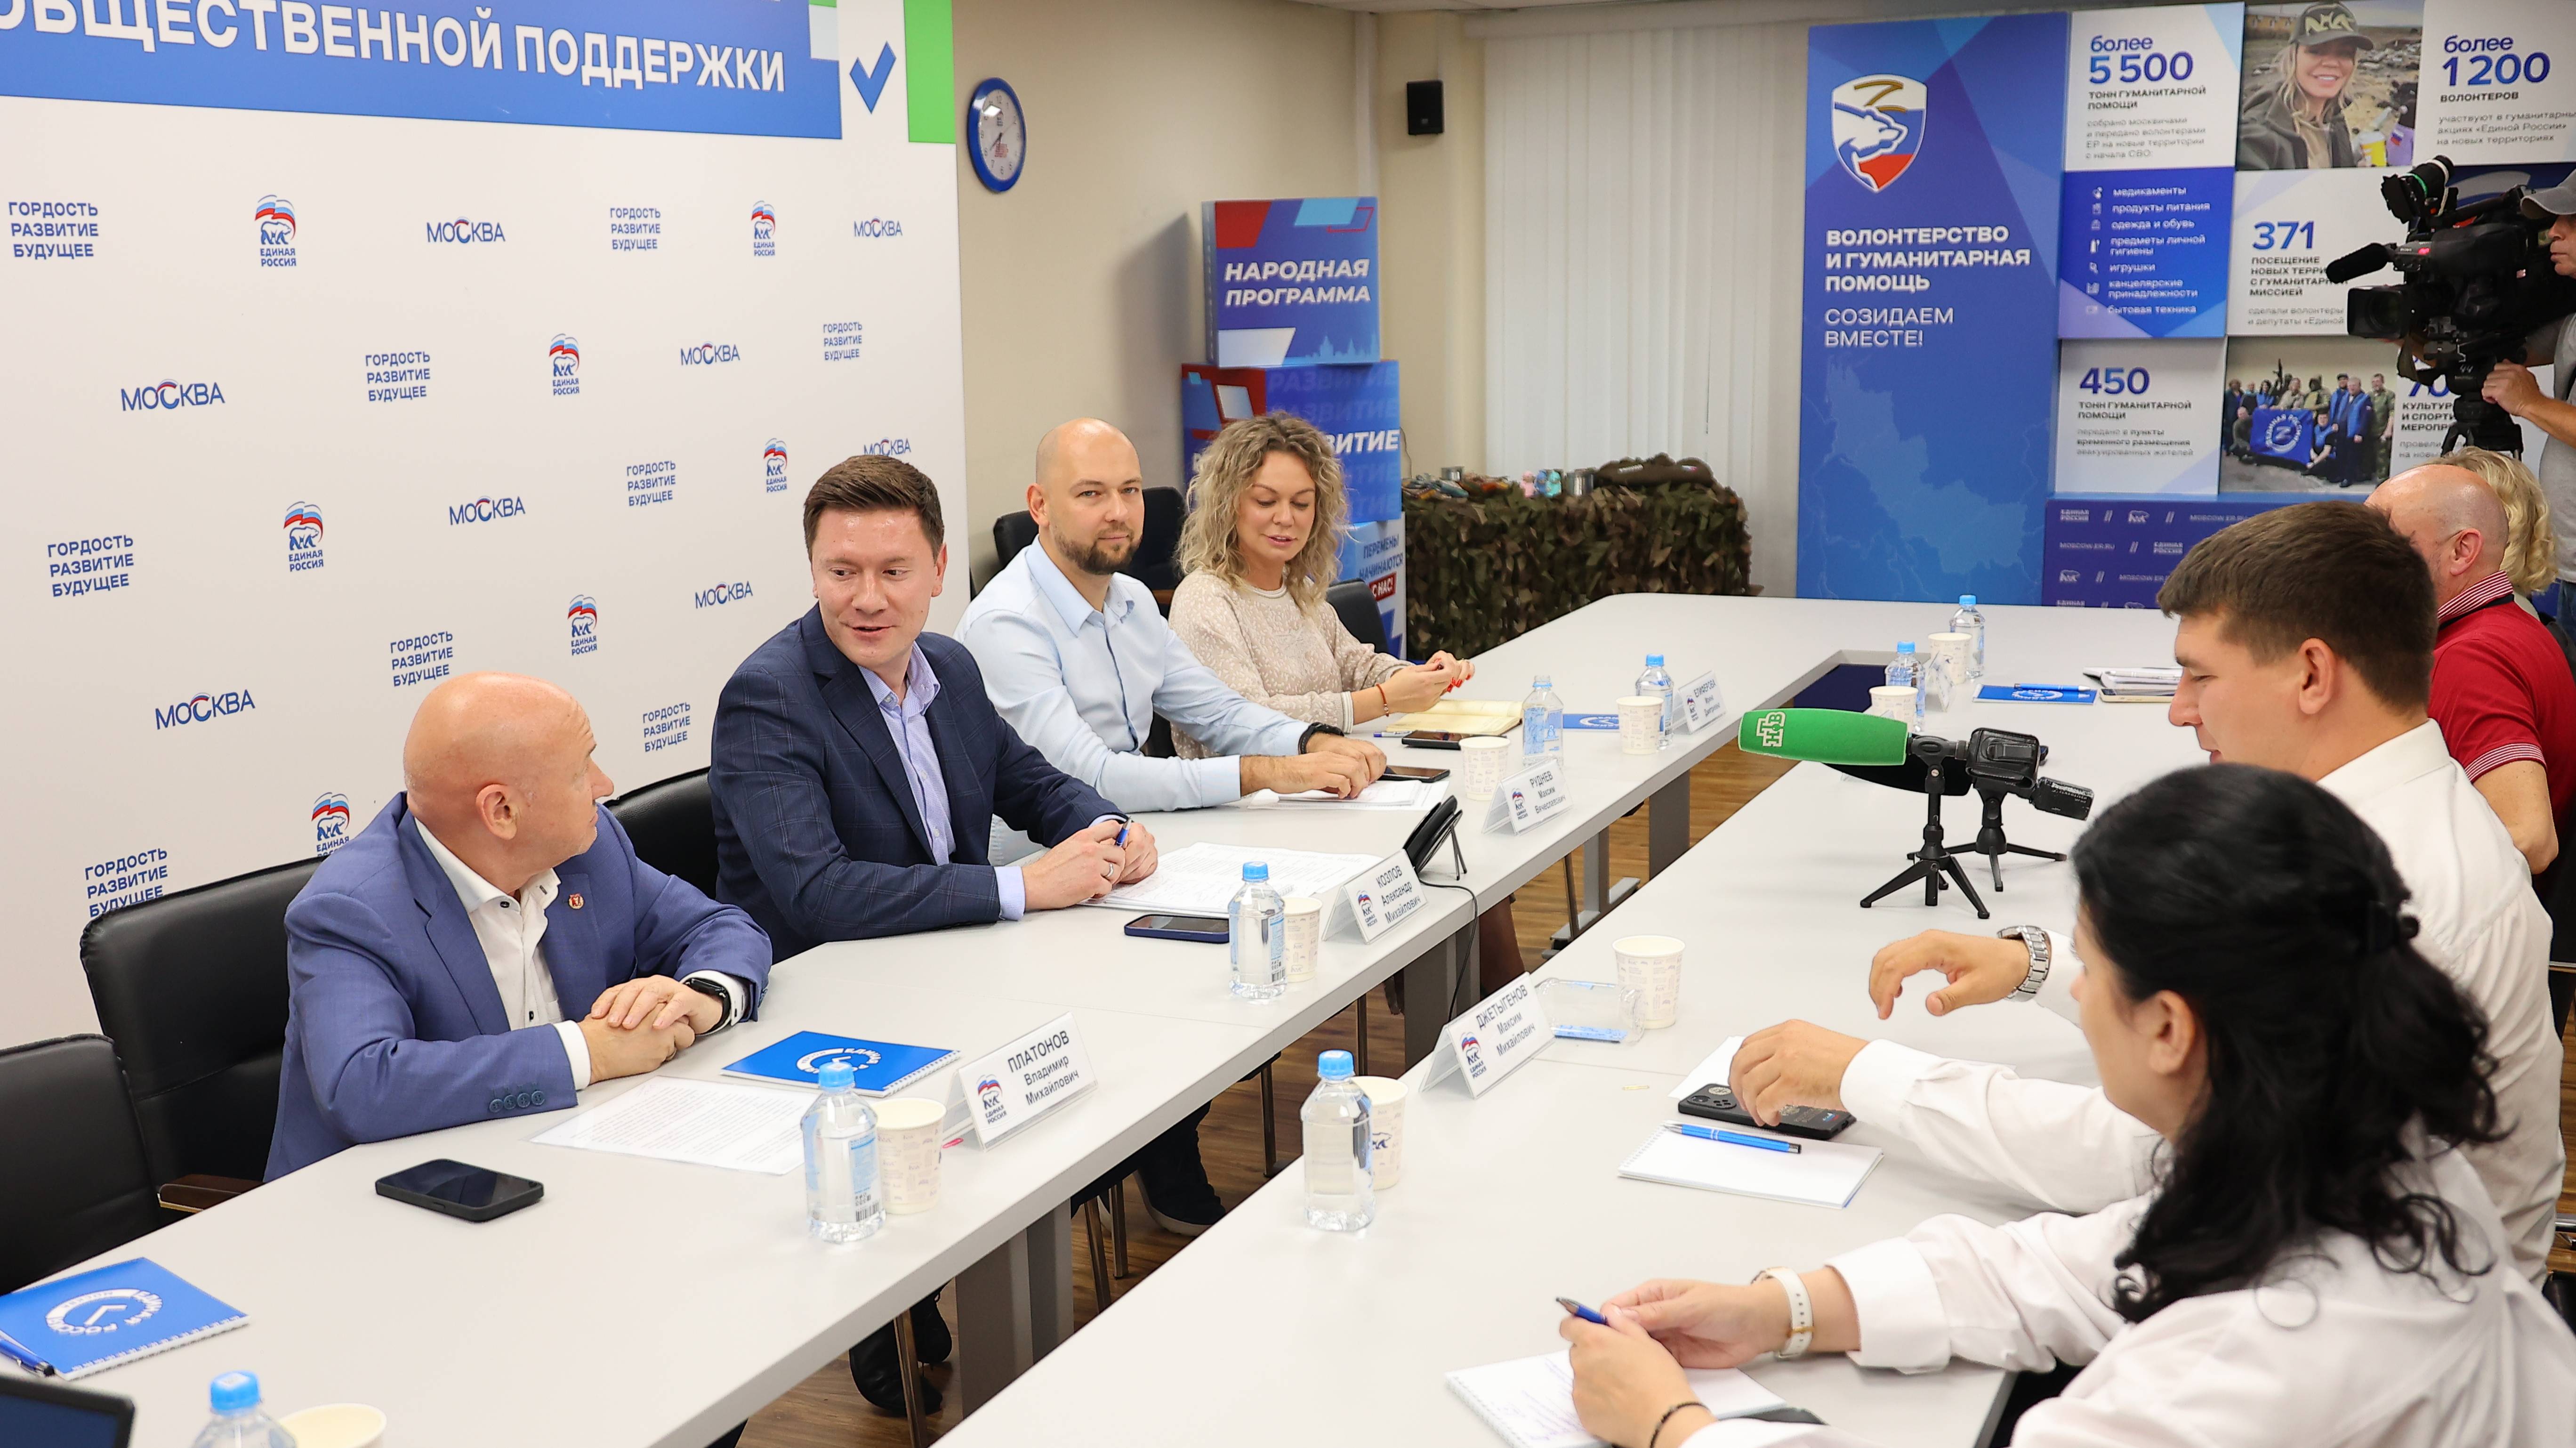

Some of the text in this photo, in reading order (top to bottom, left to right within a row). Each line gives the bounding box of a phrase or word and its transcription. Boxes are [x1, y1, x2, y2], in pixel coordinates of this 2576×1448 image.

[2091, 35, 2153, 52] более
[2444, 34, 2514, 53] более
[515, 24, 785, 92] ПОДДЕРЖКИ
[2089, 85, 2206, 99] ТОНН ГУМАНИТАРНОЙ
[2440, 91, 2519, 103] ВОЛОНТЕРОВ
[2088, 101, 2138, 110] ПОМОЩИ
[2506, 111, 2576, 121] гуманитарны
[2113, 187, 2187, 197] медикаменты
[8, 202, 98, 218] ГОРДОСТЬ
[610, 207, 660, 219] ГОРДОСТЬ
[2112, 202, 2210, 214] продукты питания
[11, 222, 98, 237] РАЗВИТИЕ
[427, 218, 505, 244] МОСКВА
[611, 222, 660, 235] РАЗВИТИЕ
[853, 218, 902, 238] МОСКВА
[2111, 220, 2151, 230] одежда
[2163, 218, 2195, 230] обувь
[1826, 226, 2009, 246] ВОЛОНТЕРСТВО
[2110, 234, 2206, 247] предметы личной
[2252, 220, 2314, 250] 371
[13, 243, 94, 259] БУДУЩЕЕ
[260, 247, 296, 258] ЕДИНАЯ
[612, 238, 658, 251] БУДУЩЕЕ
[261, 257, 297, 267] РОССИЯ
[1826, 249, 2031, 269] И ГУМАНИТАРНАЯ
[2252, 256, 2320, 265] ПОСЕЩЕНИЕ
[1225, 259, 1370, 282] НАРОДНАЯ
[2109, 264, 2156, 275] игрушки
[2251, 267, 2289, 275] НОВЫХ
[1825, 275, 1930, 293] ПОМОЩЬ
[2249, 287, 2303, 297] МИССИЕЙ
[1225, 285, 1371, 306] ПРОГРАММА
[1825, 307, 1954, 327] СОЗИДАЕМ
[823, 321, 862, 334] ГОРДОСТЬ
[823, 335, 862, 347] РАЗВИТИЕ
[1825, 331, 1923, 348] ВМЕСТЕ!
[365, 351, 430, 367] ГОРДОСТЬ
[680, 342, 740, 366] МОСКВА
[824, 348, 860, 362] БУДУЩЕЕ
[367, 368, 430, 384] РАЗВИТИЕ
[552, 378, 579, 387] ЕДИНАЯ
[2079, 367, 2150, 395] 450
[121, 380, 225, 411] МОСКВА
[369, 386, 427, 403] БУДУЩЕЕ
[553, 386, 580, 396] РОССИЯ
[2108, 400, 2191, 409] ГУМАНИТАРНОЙ
[2078, 412, 2125, 420] ПОМОЩИ
[864, 438, 911, 456] МОСКВА
[1328, 429, 1400, 455] ВИТИЕ
[626, 460, 676, 477] ГОРДОСТЬ
[628, 475, 676, 492] РАЗВИТИЕ
[766, 476, 787, 486] ЕДИНАЯ
[766, 483, 788, 493] РОССИЯ
[628, 490, 673, 507] БУДУЩЕЕ
[449, 496, 525, 526] МОСКВА
[47, 534, 134, 558] ГОРДОСТЬ
[1363, 534, 1399, 558] ПЕРЕМЕНЫ
[289, 550, 323, 562] ЕДИНАЯ
[49, 553, 134, 577] РАЗВИТИЕ
[290, 559, 324, 572] РОССИЯ
[1359, 553, 1403, 579] НАЧИНАЮТСЯ
[52, 574, 129, 597] БУДУЩЕЕ
[1377, 577, 1393, 595] НАС!
[695, 581, 753, 609] МОСКВА
[390, 631, 453, 654] ГОРДОСТЬ
[571, 635, 597, 647] ЕДИНАЯ
[572, 643, 597, 656] РОССИЯ
[391, 647, 453, 670] РАЗВИТИЕ
[393, 663, 450, 687] БУДУЩЕЕ
[155, 690, 255, 730] МОСКВА
[643, 702, 691, 724] ГОРДОСТЬ
[644, 715, 691, 738] РАЗВИТИЕ
[644, 730, 688, 752] БУДУЩЕЕ
[1530, 771, 1553, 788] РУДНЕВ
[1538, 787, 1555, 799] Максим
[316, 836, 349, 852] ЕДИНАЯ
[85, 848, 168, 880] ГОРДОСТЬ
[87, 865, 168, 899] РАЗВИТИЕ
[1376, 866, 1402, 888] КОЗЛОВ
[1381, 882, 1412, 906] Александр
[1385, 895, 1421, 923] Михайлович
[1476, 985, 1528, 1030] ДЖЕТЫГЕНОВ
[1497, 1012, 1523, 1035] Максим
[1497, 1023, 1536, 1056] Михайлович
[1008, 1030, 1069, 1073] ПЛАТОНОВ
[1024, 1056, 1069, 1086] Владимир
[1025, 1070, 1079, 1105] Михайлович
[985, 1105, 1005, 1118] ЕДИНАЯ
[988, 1111, 1007, 1124] РОССИЯ
